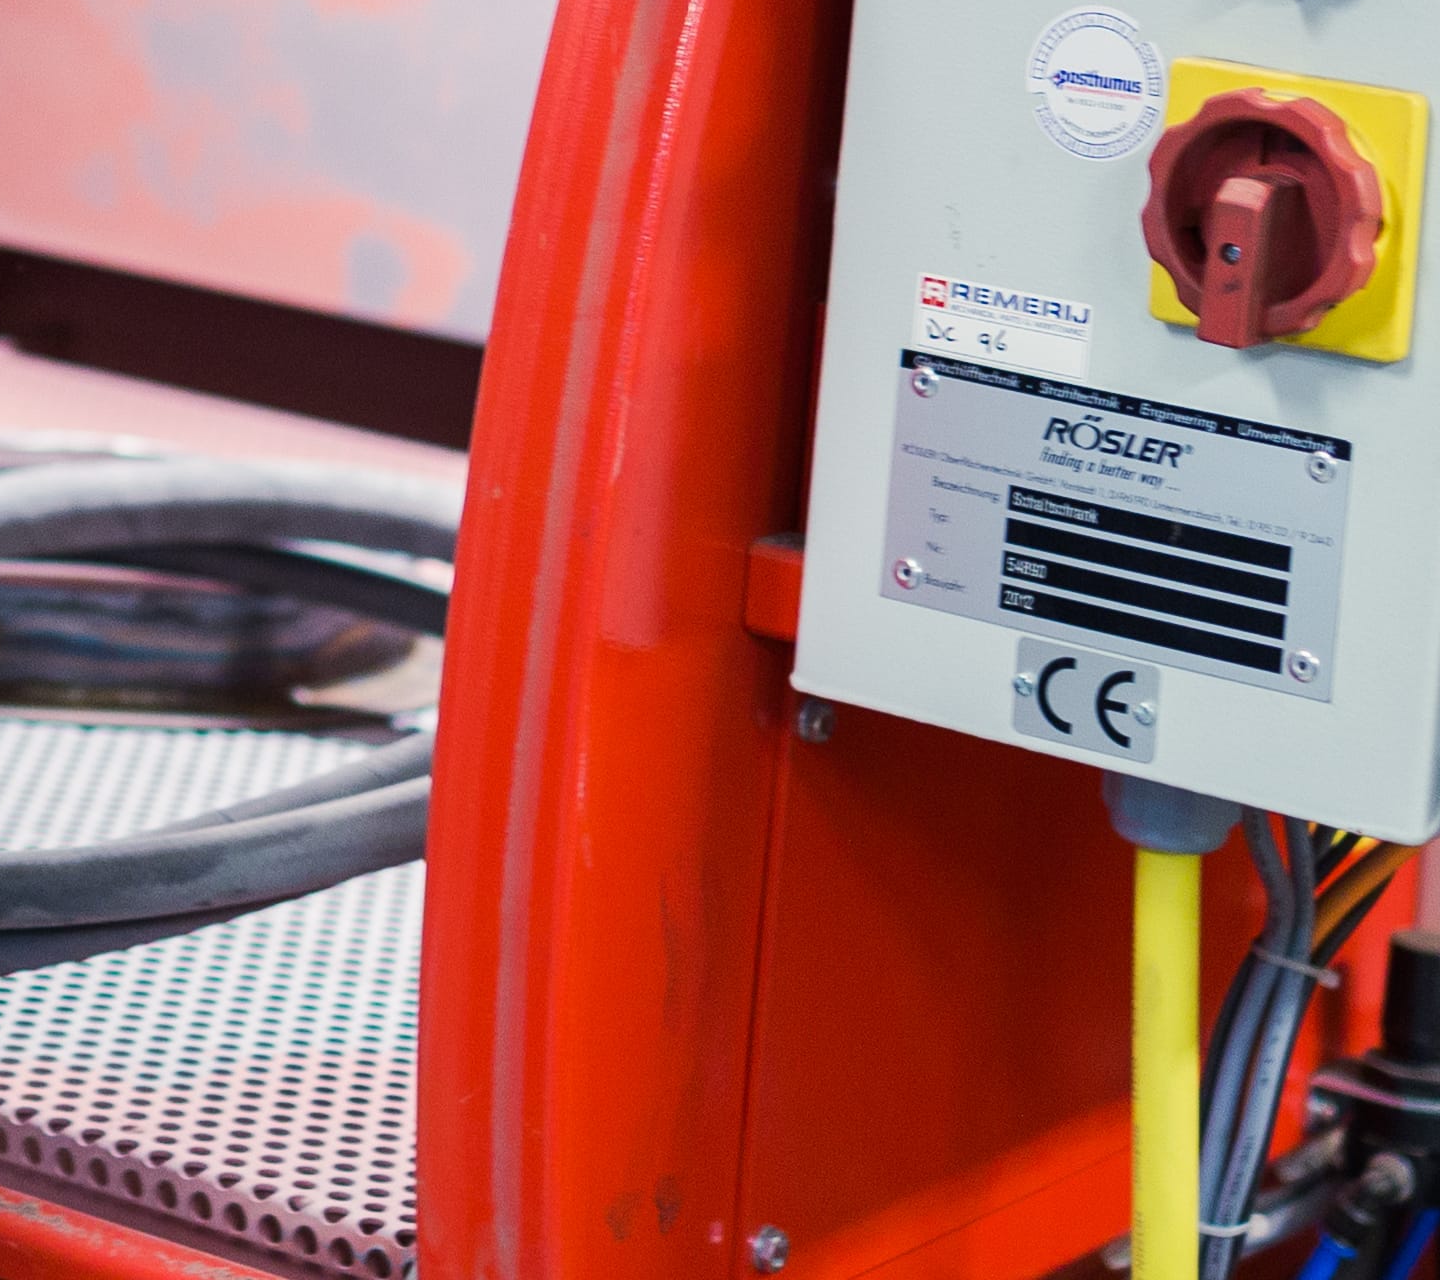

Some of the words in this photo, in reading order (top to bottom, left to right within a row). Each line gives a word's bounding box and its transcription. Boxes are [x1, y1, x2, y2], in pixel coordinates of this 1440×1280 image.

[951, 283, 1091, 324] REMERIJ
[1139, 402, 1218, 433] Engineering
[1040, 446, 1082, 473] finding
[1097, 456, 1134, 482] better
[1037, 656, 1136, 749] CE
